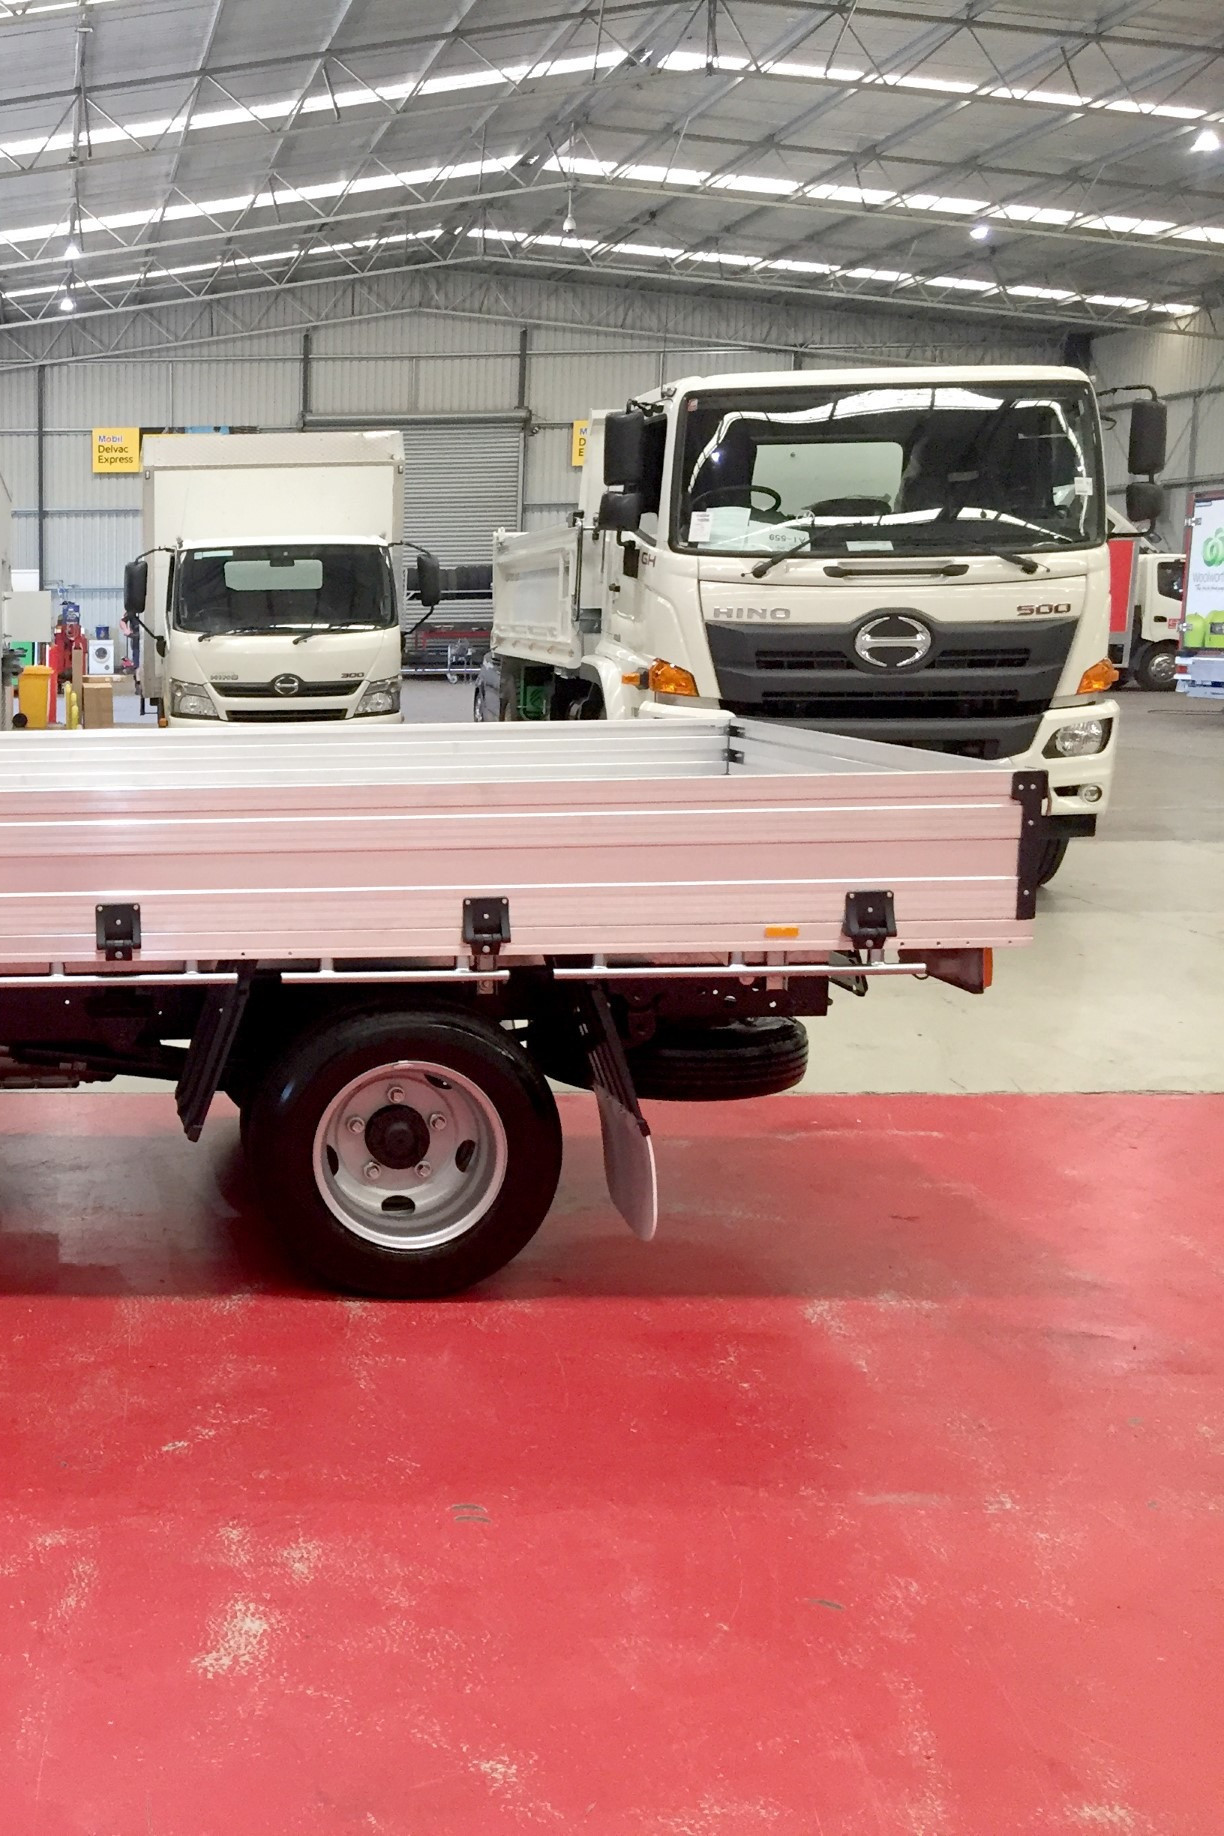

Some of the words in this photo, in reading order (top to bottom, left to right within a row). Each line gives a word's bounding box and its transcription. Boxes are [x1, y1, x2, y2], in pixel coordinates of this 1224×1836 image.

[98, 445, 129, 453] Delvac
[98, 455, 134, 466] Express
[641, 552, 656, 568] GH
[713, 606, 791, 620] HINO
[1017, 603, 1071, 616] 500
